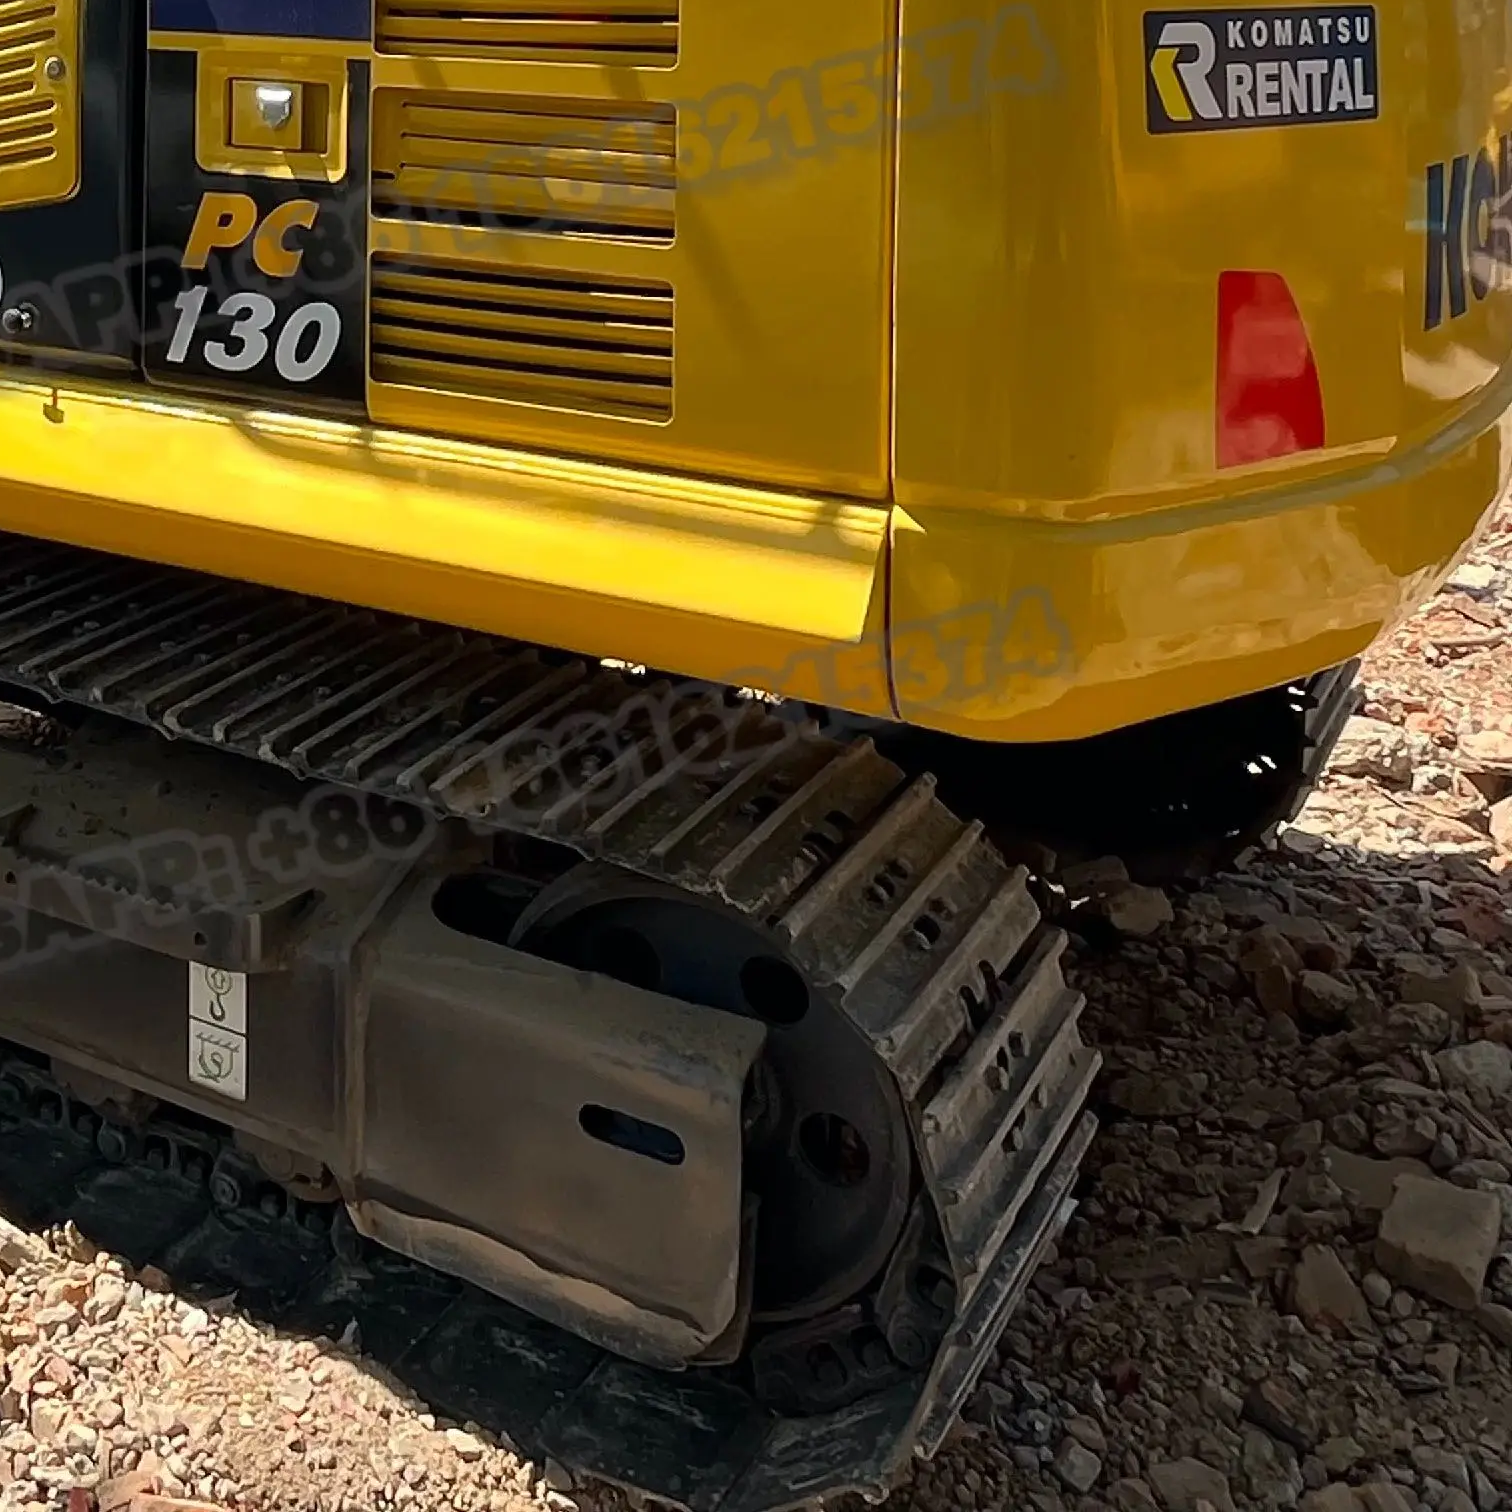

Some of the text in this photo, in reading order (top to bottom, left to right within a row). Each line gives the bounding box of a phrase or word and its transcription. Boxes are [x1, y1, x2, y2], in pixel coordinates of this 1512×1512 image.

[1226, 16, 1370, 48] KOMATSU
[1226, 57, 1375, 119] RENTAL
[181, 192, 320, 278] PC
[1424, 133, 1512, 331] KO
[166, 285, 341, 382] 130
